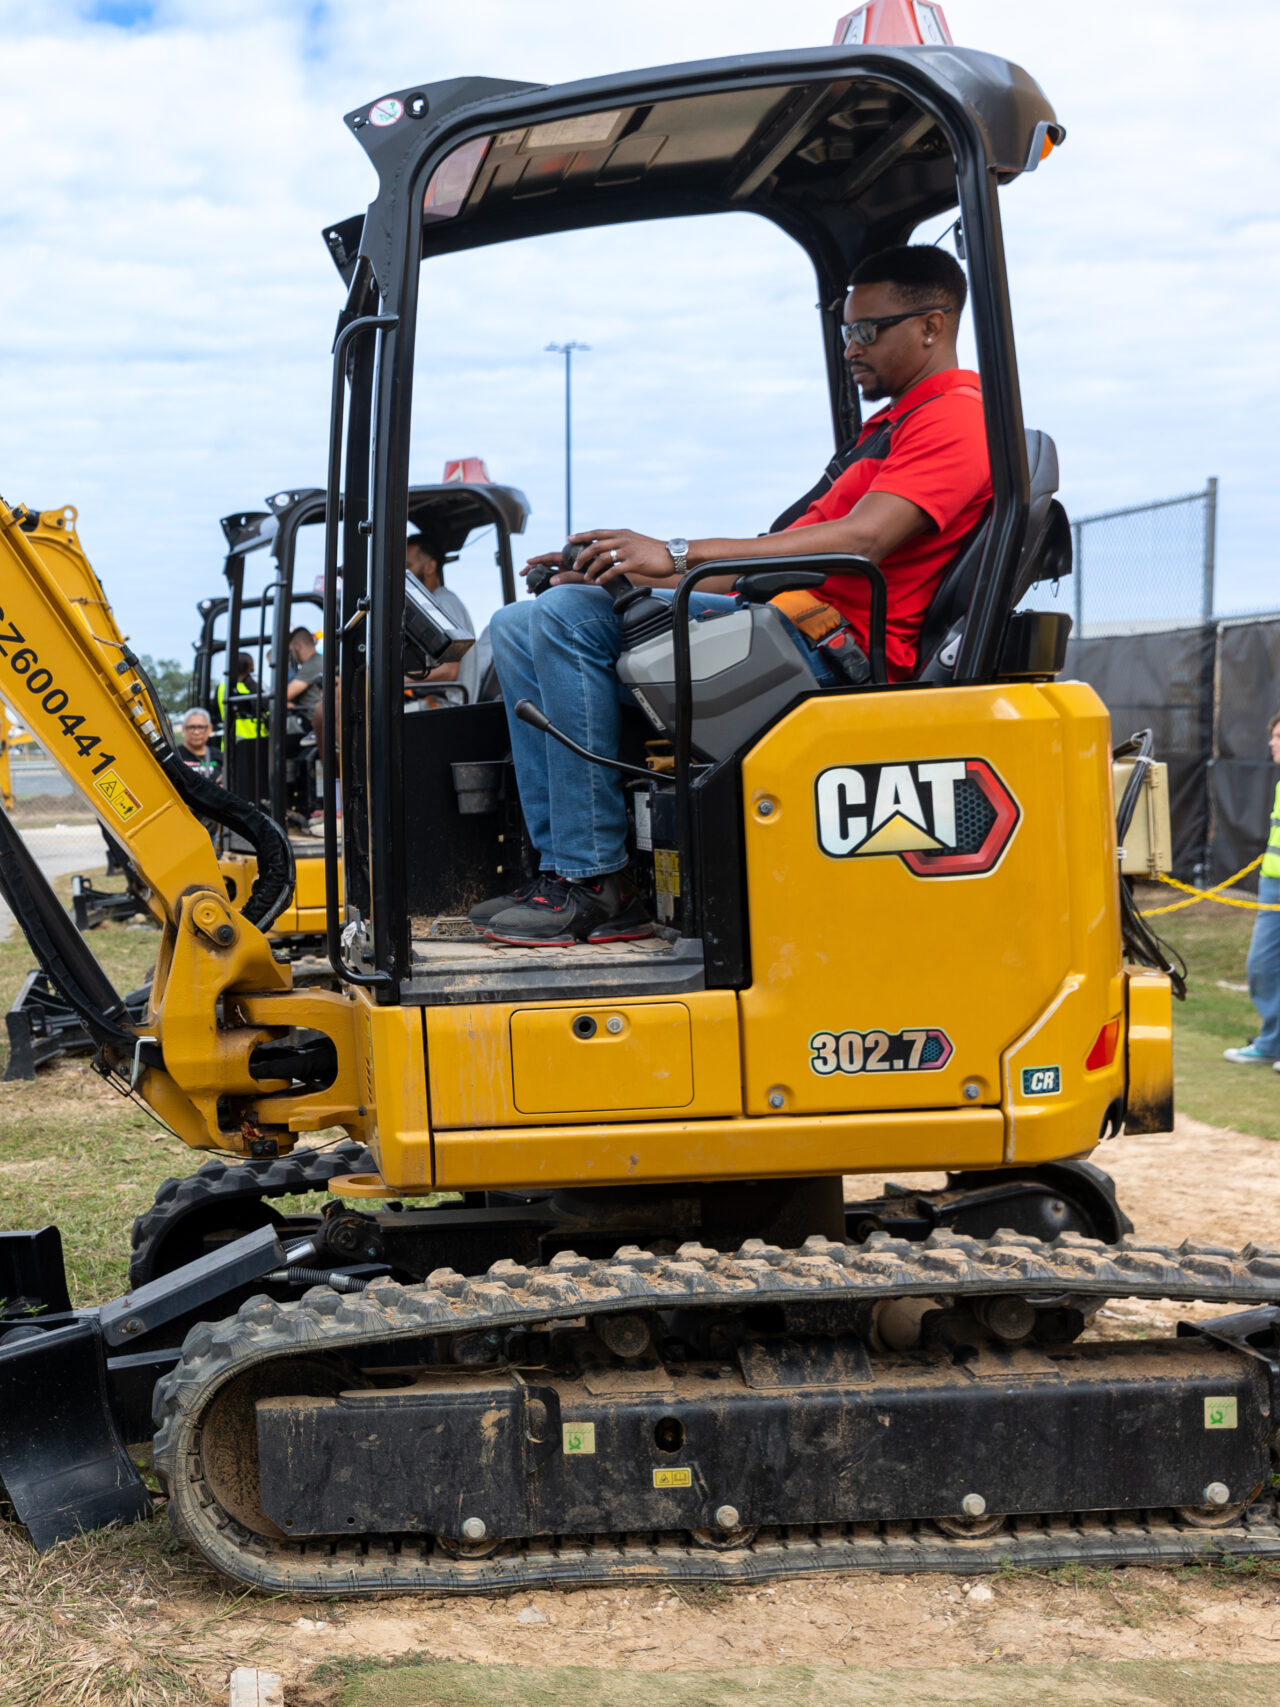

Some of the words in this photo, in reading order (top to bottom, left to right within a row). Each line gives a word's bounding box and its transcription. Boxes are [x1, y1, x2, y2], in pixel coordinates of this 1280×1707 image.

[817, 761, 967, 855] CAT
[812, 1031, 928, 1074] 302.7
[1031, 1071, 1055, 1091] CR
